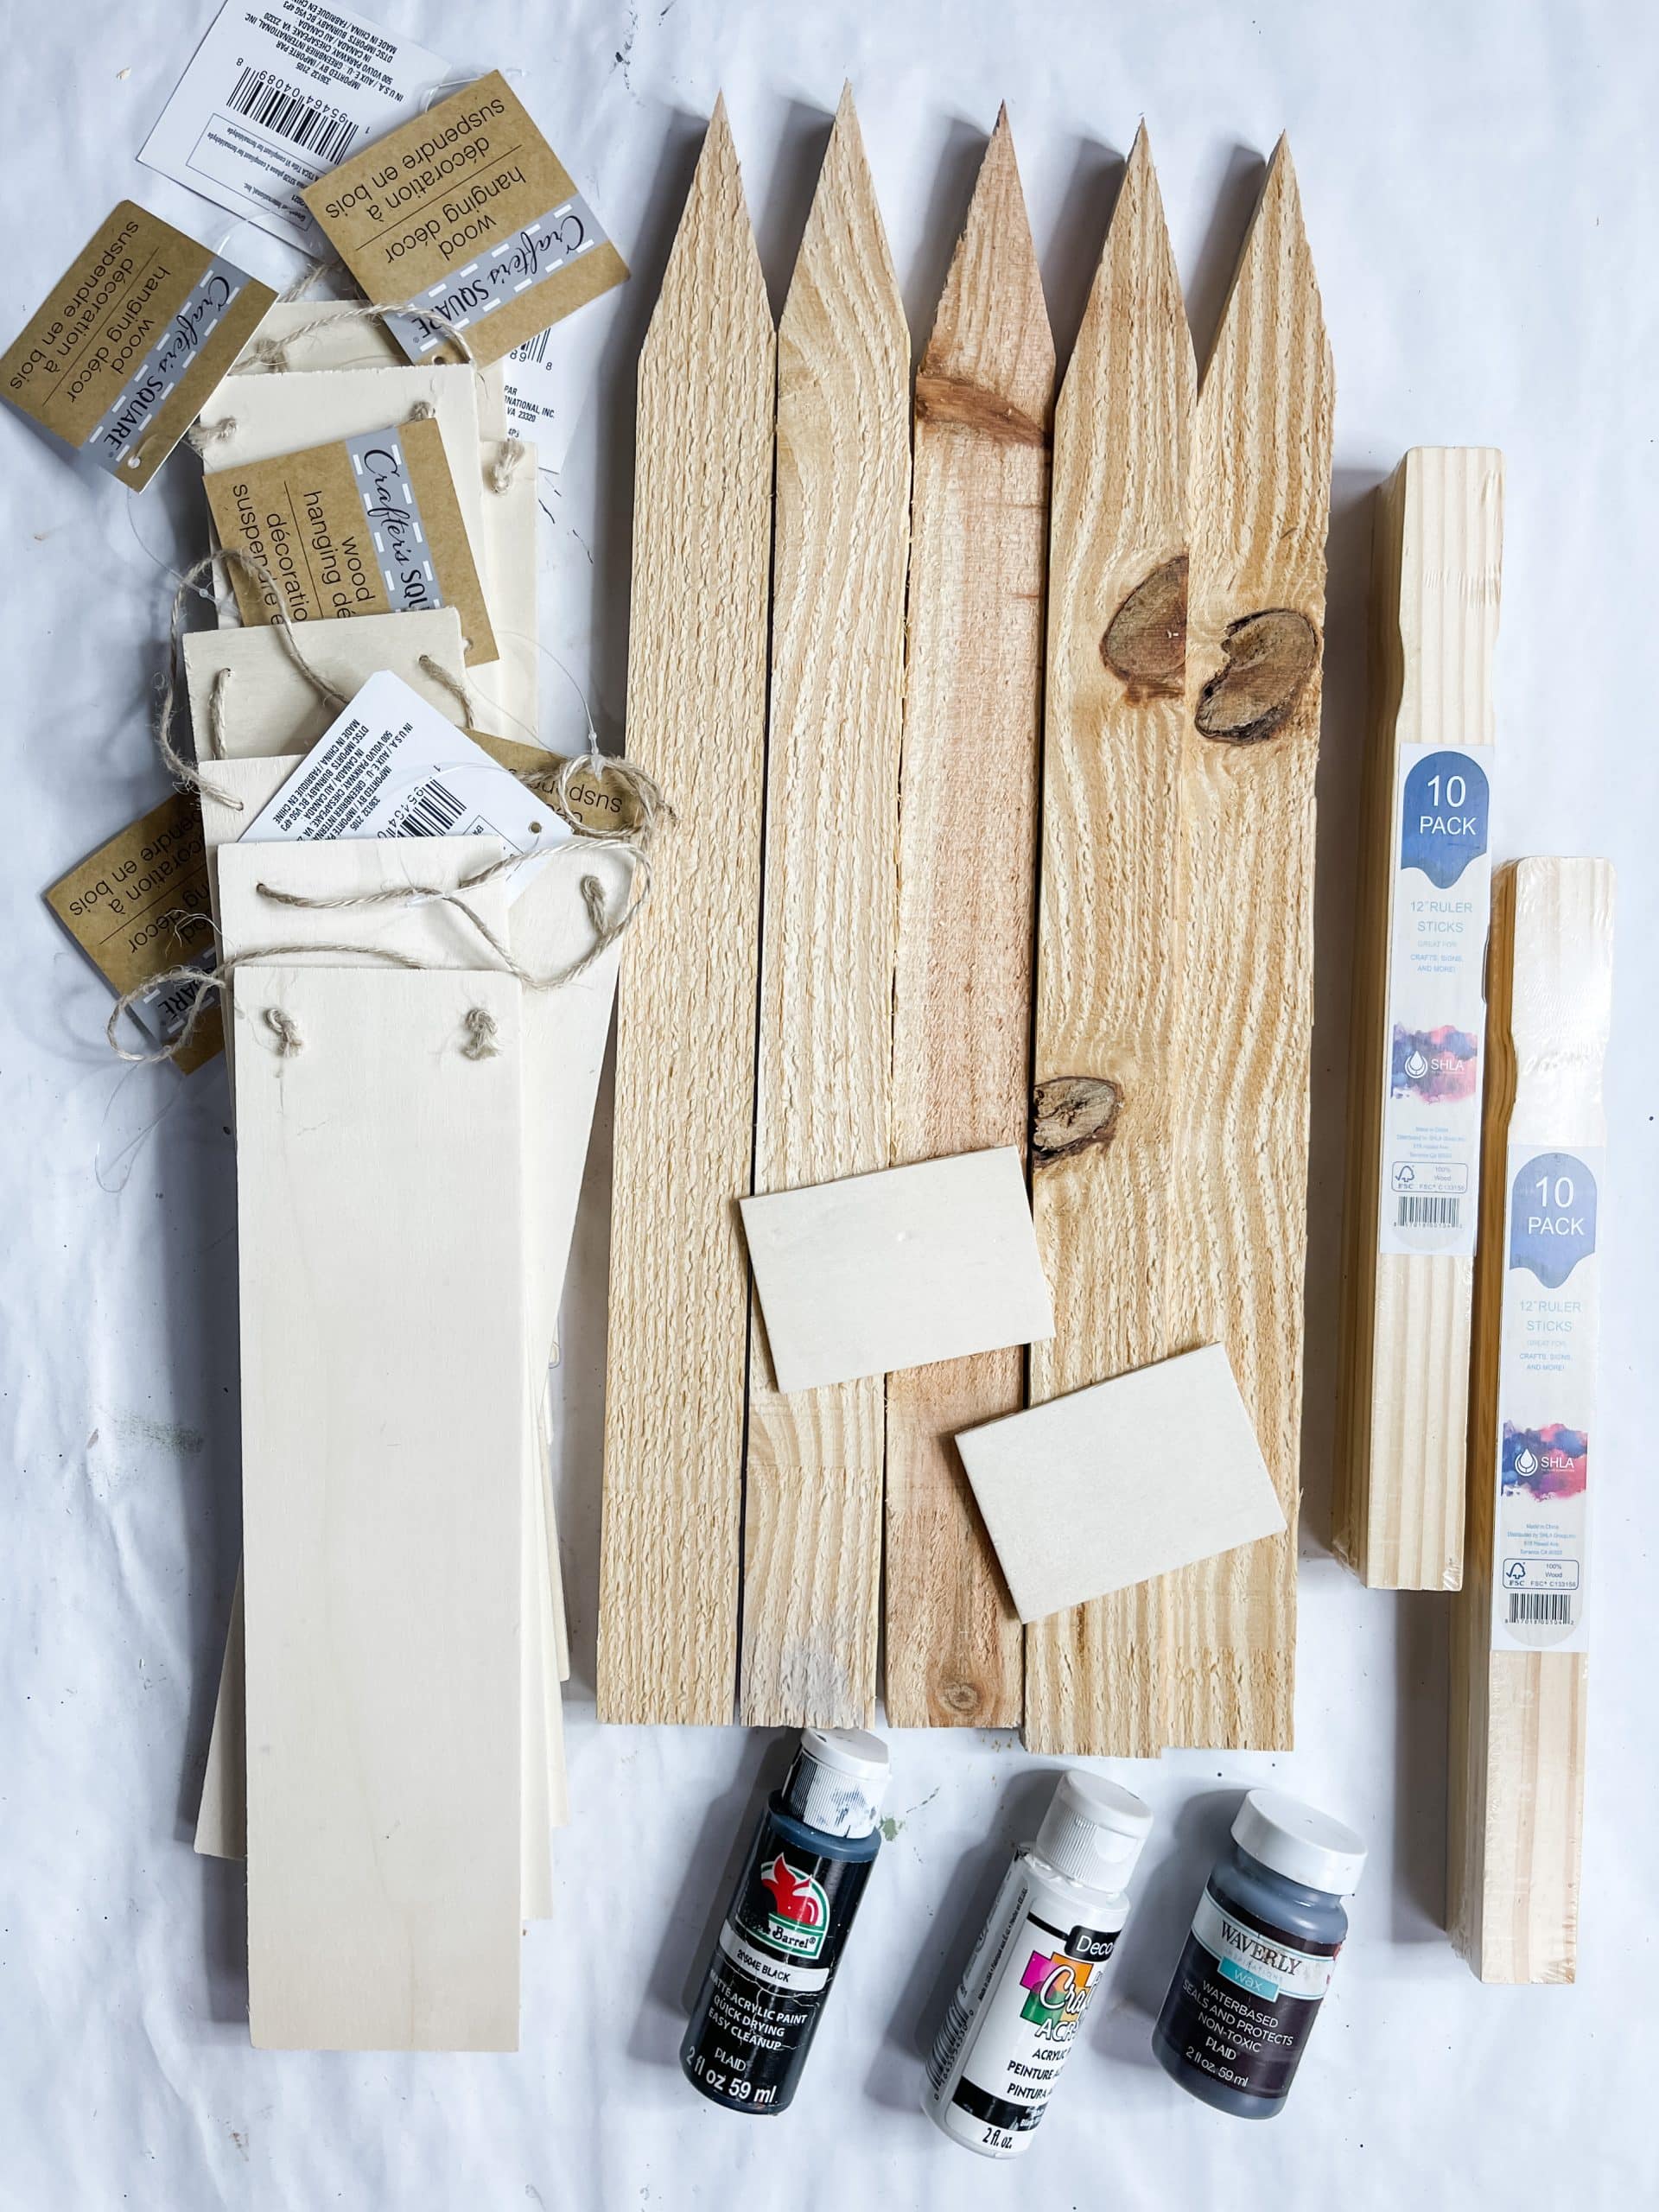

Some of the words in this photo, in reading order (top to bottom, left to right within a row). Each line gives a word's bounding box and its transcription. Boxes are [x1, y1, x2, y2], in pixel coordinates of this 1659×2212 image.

[283, 1, 295, 11] 4P3
[308, 3, 318, 13] EN
[264, 12, 282, 26] 23320
[282, 22, 291, 31] VA
[306, 13, 317, 22] BC
[323, 33, 334, 42] AU
[351, 25, 371, 40] CHINA
[370, 35, 378, 44] IN
[276, 41, 289, 52] PAR
[337, 40, 363, 58] CANADA
[347, 35, 377, 54] IMPORTS
[377, 40, 397, 54] MADE
[236, 58, 244, 67] 8
[305, 45, 343, 69] GREENBRIER
[363, 54, 372, 62] IN
[375, 49, 393, 63] DTSC
[319, 64, 329, 73] BY
[361, 64, 382, 79] VOLVO
[259, 70, 301, 98] 04089
[328, 69, 361, 90] IMPORTED
[359, 74, 374, 86] AUX
[381, 74, 393, 85] 500
[395, 92, 404, 102] IN
[306, 95, 347, 123] 95464
[403, 99, 505, 169] suspendre
[372, 166, 398, 188] en
[385, 137, 489, 208] décoration
[326, 184, 372, 218] bois
[442, 166, 526, 224] hanging
[366, 205, 384, 222] à
[385, 219, 441, 264] décor
[438, 214, 497, 261] wood
[490, 215, 584, 284] Crafter's
[64, 221, 138, 317] suspendre
[56, 258, 133, 356] décoration
[106, 266, 171, 343] hanging
[41, 322, 63, 345] en
[159, 276, 230, 372] Crafter's
[110, 320, 155, 374] wood
[10, 349, 47, 389] bois
[43, 359, 60, 373] à
[67, 347, 109, 403] décor
[104, 376, 163, 450] SQUARE
[364, 449, 410, 564] Crafter's
[303, 491, 341, 584] hanging
[341, 536, 376, 601] wood
[341, 719, 360, 740] MADE
[353, 726, 369, 744] DTSC
[380, 730, 392, 743] 500
[403, 722, 413, 733] IN
[335, 737, 346, 747] IN
[365, 741, 385, 762] VOLVO
[320, 745, 340, 765] CHINA
[331, 741, 356, 770] IMPORTS
[354, 748, 365, 759] IN
[376, 750, 390, 766] AUX
[334, 756, 358, 783] CANADA
[324, 783, 334, 796] AU
[364, 766, 391, 798] IMPORTED
[1427, 775, 1466, 807] 10
[288, 795, 299, 806] EN
[299, 798, 310, 809] BC
[334, 779, 366, 817] GREENBRIER
[357, 795, 367, 807] BY
[361, 796, 380, 817] 336132
[273, 804, 291, 824] CHINE
[289, 807, 302, 821] V5G
[350, 815, 364, 831] 2105
[280, 819, 292, 831] 4P3
[303, 827, 315, 836] VA
[1420, 816, 1477, 836] PACK
[111, 861, 137, 882] en
[69, 880, 114, 916] bois
[108, 899, 126, 914] à
[1430, 902, 1472, 913] RULER
[1417, 921, 1464, 933] STICKS
[1431, 1058, 1465, 1071] SHLA
[1535, 1176, 1574, 1208] 10
[1528, 1217, 1584, 1236] PACK
[1538, 1300, 1581, 1313] RULER
[1526, 1320, 1573, 1332] STICKS
[1541, 1456, 1574, 1469] SHLA
[1221, 1920, 1302, 1976] WAVERLY
[761, 1965, 791, 1982] BLACK
[1234, 1970, 1262, 1991] wax
[731, 1993, 776, 2021] ACRYLIC
[777, 2012, 808, 2025] PAINT
[1182, 1980, 1209, 2009] SEALS
[1210, 2004, 1236, 2024] AND
[1236, 2018, 1294, 2046] PROTECTS
[1202, 1980, 1279, 2028] WATERBASED
[714, 1995, 743, 2022] QUICK
[742, 2014, 785, 2037] DRYING
[709, 2008, 731, 2031] EASY
[732, 2026, 782, 2051] CLEANUP
[1198, 2012, 1262, 2053] NON-TOXIC
[1205, 2037, 1236, 2060] PLAID
[715, 2047, 747, 2071] PLAID
[1185, 2046, 1194, 2058] 2
[1218, 2067, 1234, 2081] 59
[1234, 2076, 1249, 2087] ml
[686, 2046, 695, 2065] 2
[695, 2056, 705, 2075] fl
[706, 2069, 726, 2091] oz
[728, 2078, 751, 2099] 59
[753, 2086, 777, 2103] ml
[1007, 2060, 1054, 2080] PEINTURE
[982, 2127, 992, 2143] 2
[990, 2129, 1001, 2146] fl.
[1001, 2137, 1013, 2149] oz.
